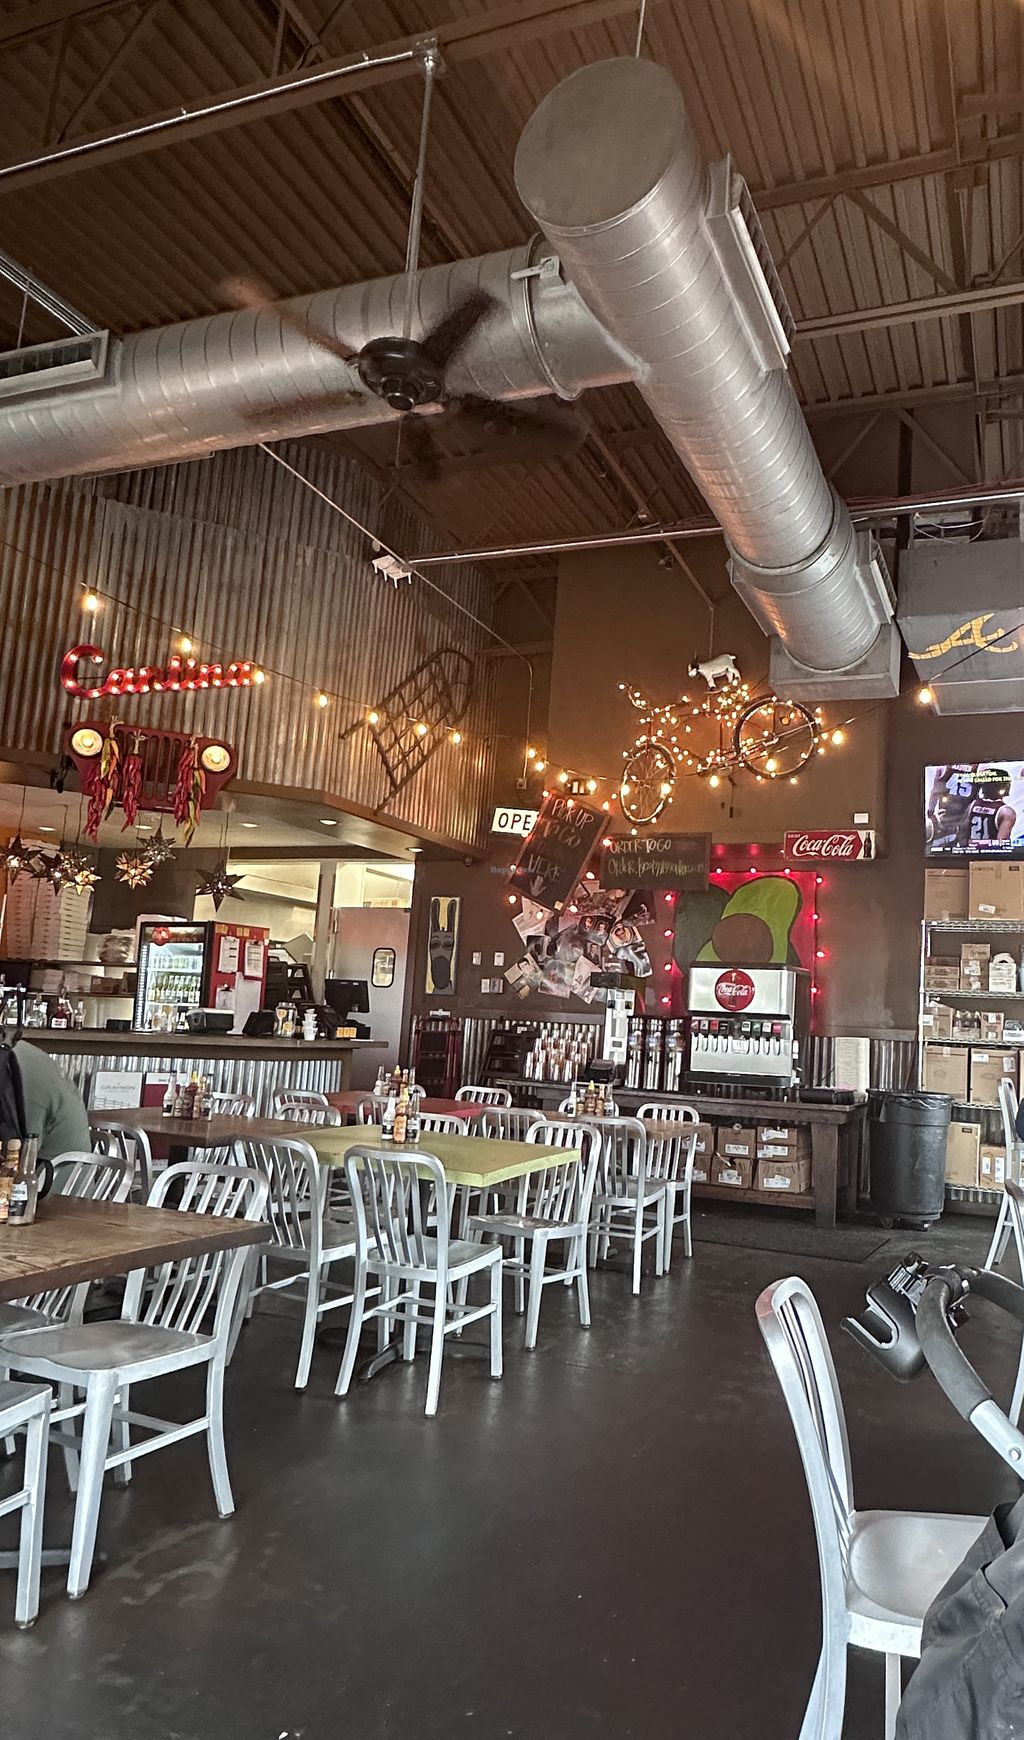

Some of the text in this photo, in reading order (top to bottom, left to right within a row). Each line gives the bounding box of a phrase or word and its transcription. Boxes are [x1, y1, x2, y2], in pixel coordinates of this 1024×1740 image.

[60, 644, 258, 698] Cantina
[498, 812, 532, 831] OPE
[576, 809, 594, 830] UP
[970, 816, 990, 840] 21
[792, 834, 857, 857] Coca-Cola
[717, 983, 751, 997] Coca-Cola
